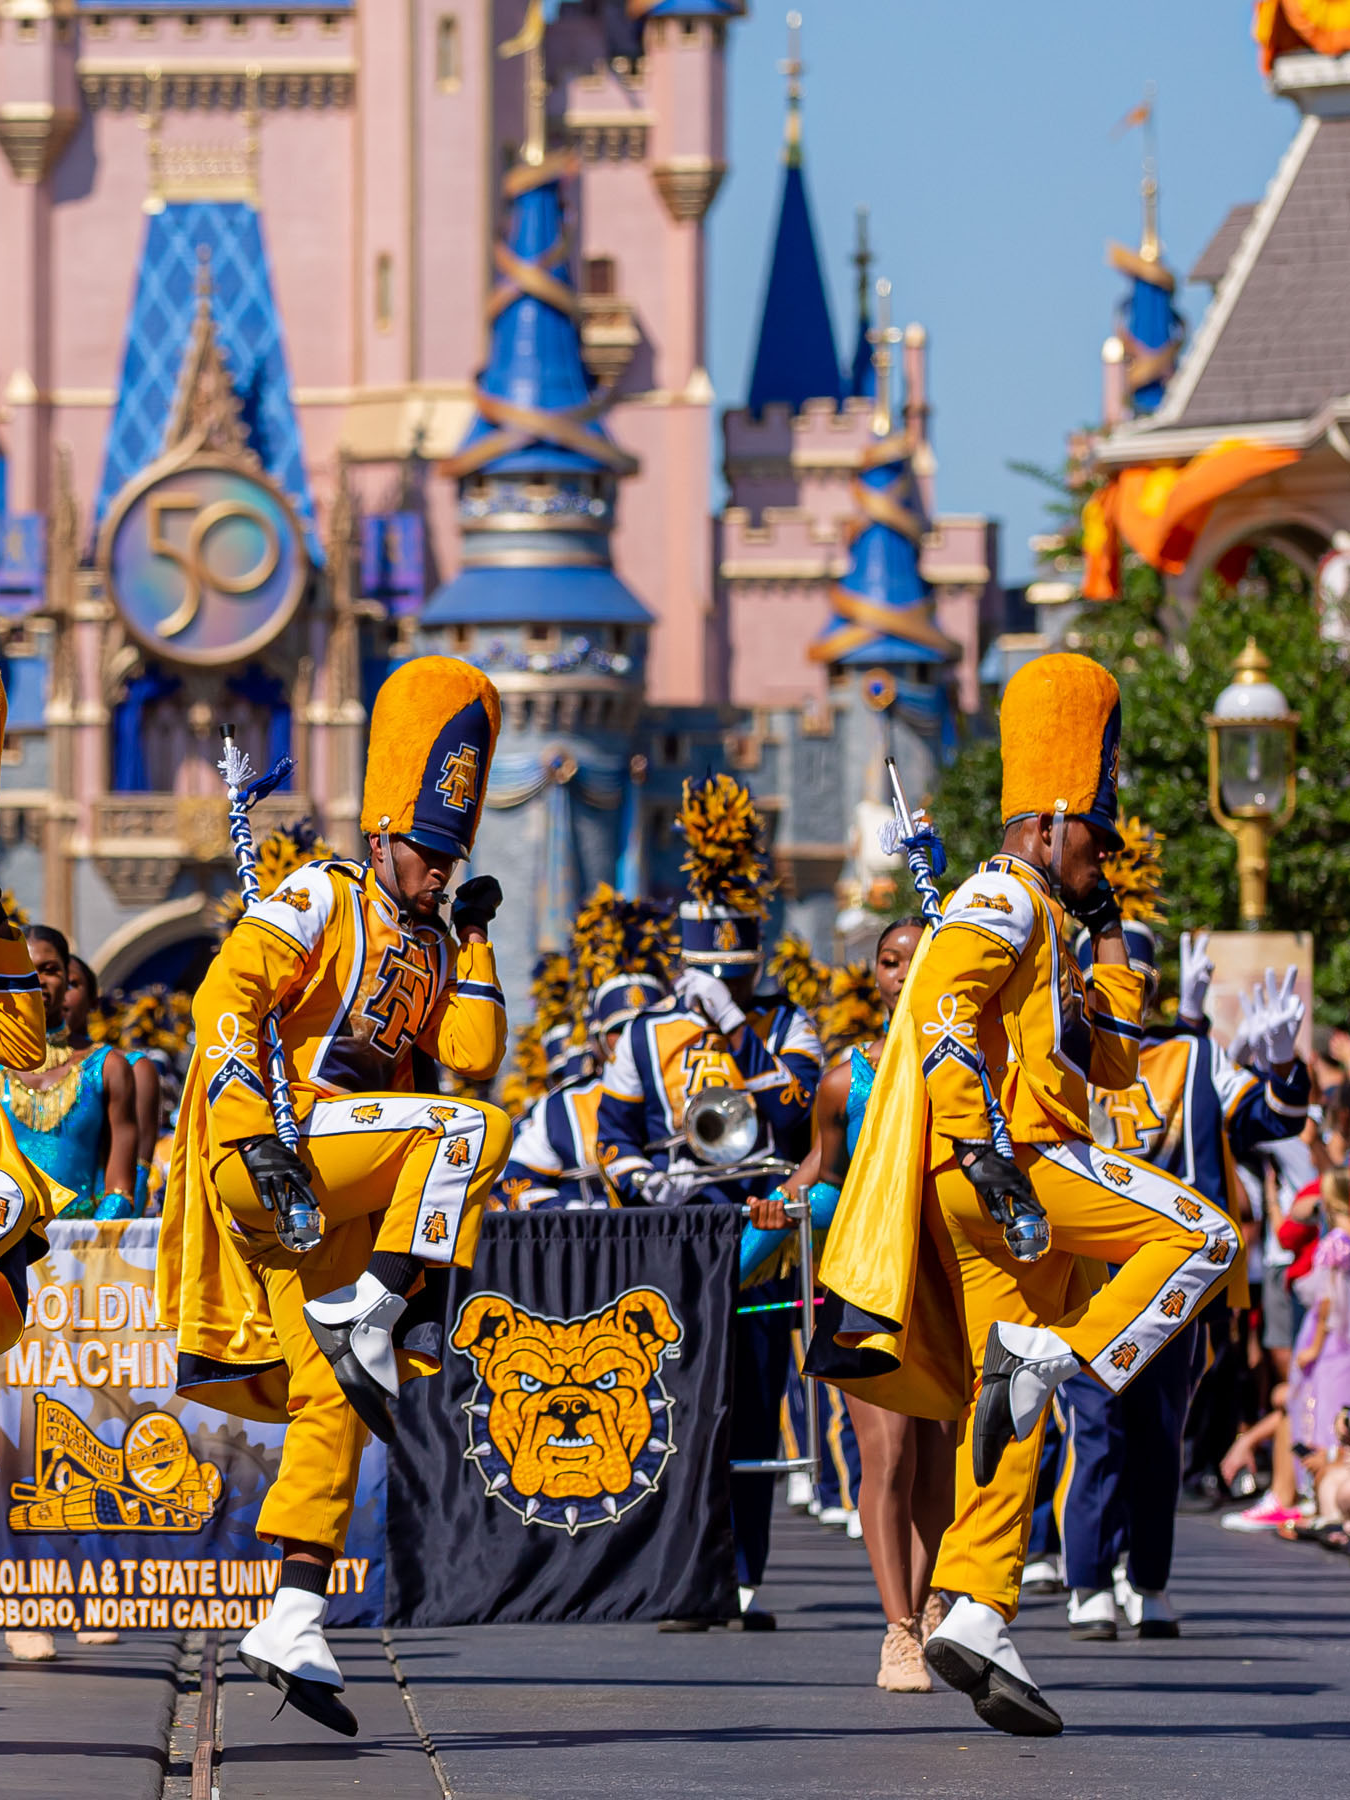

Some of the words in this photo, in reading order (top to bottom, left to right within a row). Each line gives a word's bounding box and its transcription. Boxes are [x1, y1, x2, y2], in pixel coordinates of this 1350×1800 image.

[145, 491, 279, 638] 50
[5, 1338, 178, 1388] MACHIN
[47, 1407, 119, 1467] MARCHING
[47, 1427, 119, 1479] MACHINE
[77, 1559, 99, 1594] A
[100, 1559, 119, 1596] &
[120, 1559, 138, 1596] T
[140, 1558, 217, 1596] STATE
[220, 1558, 369, 1596] UNIVITY
[84, 1598, 169, 1629] NORTH
[172, 1598, 274, 1629] CAROLI
